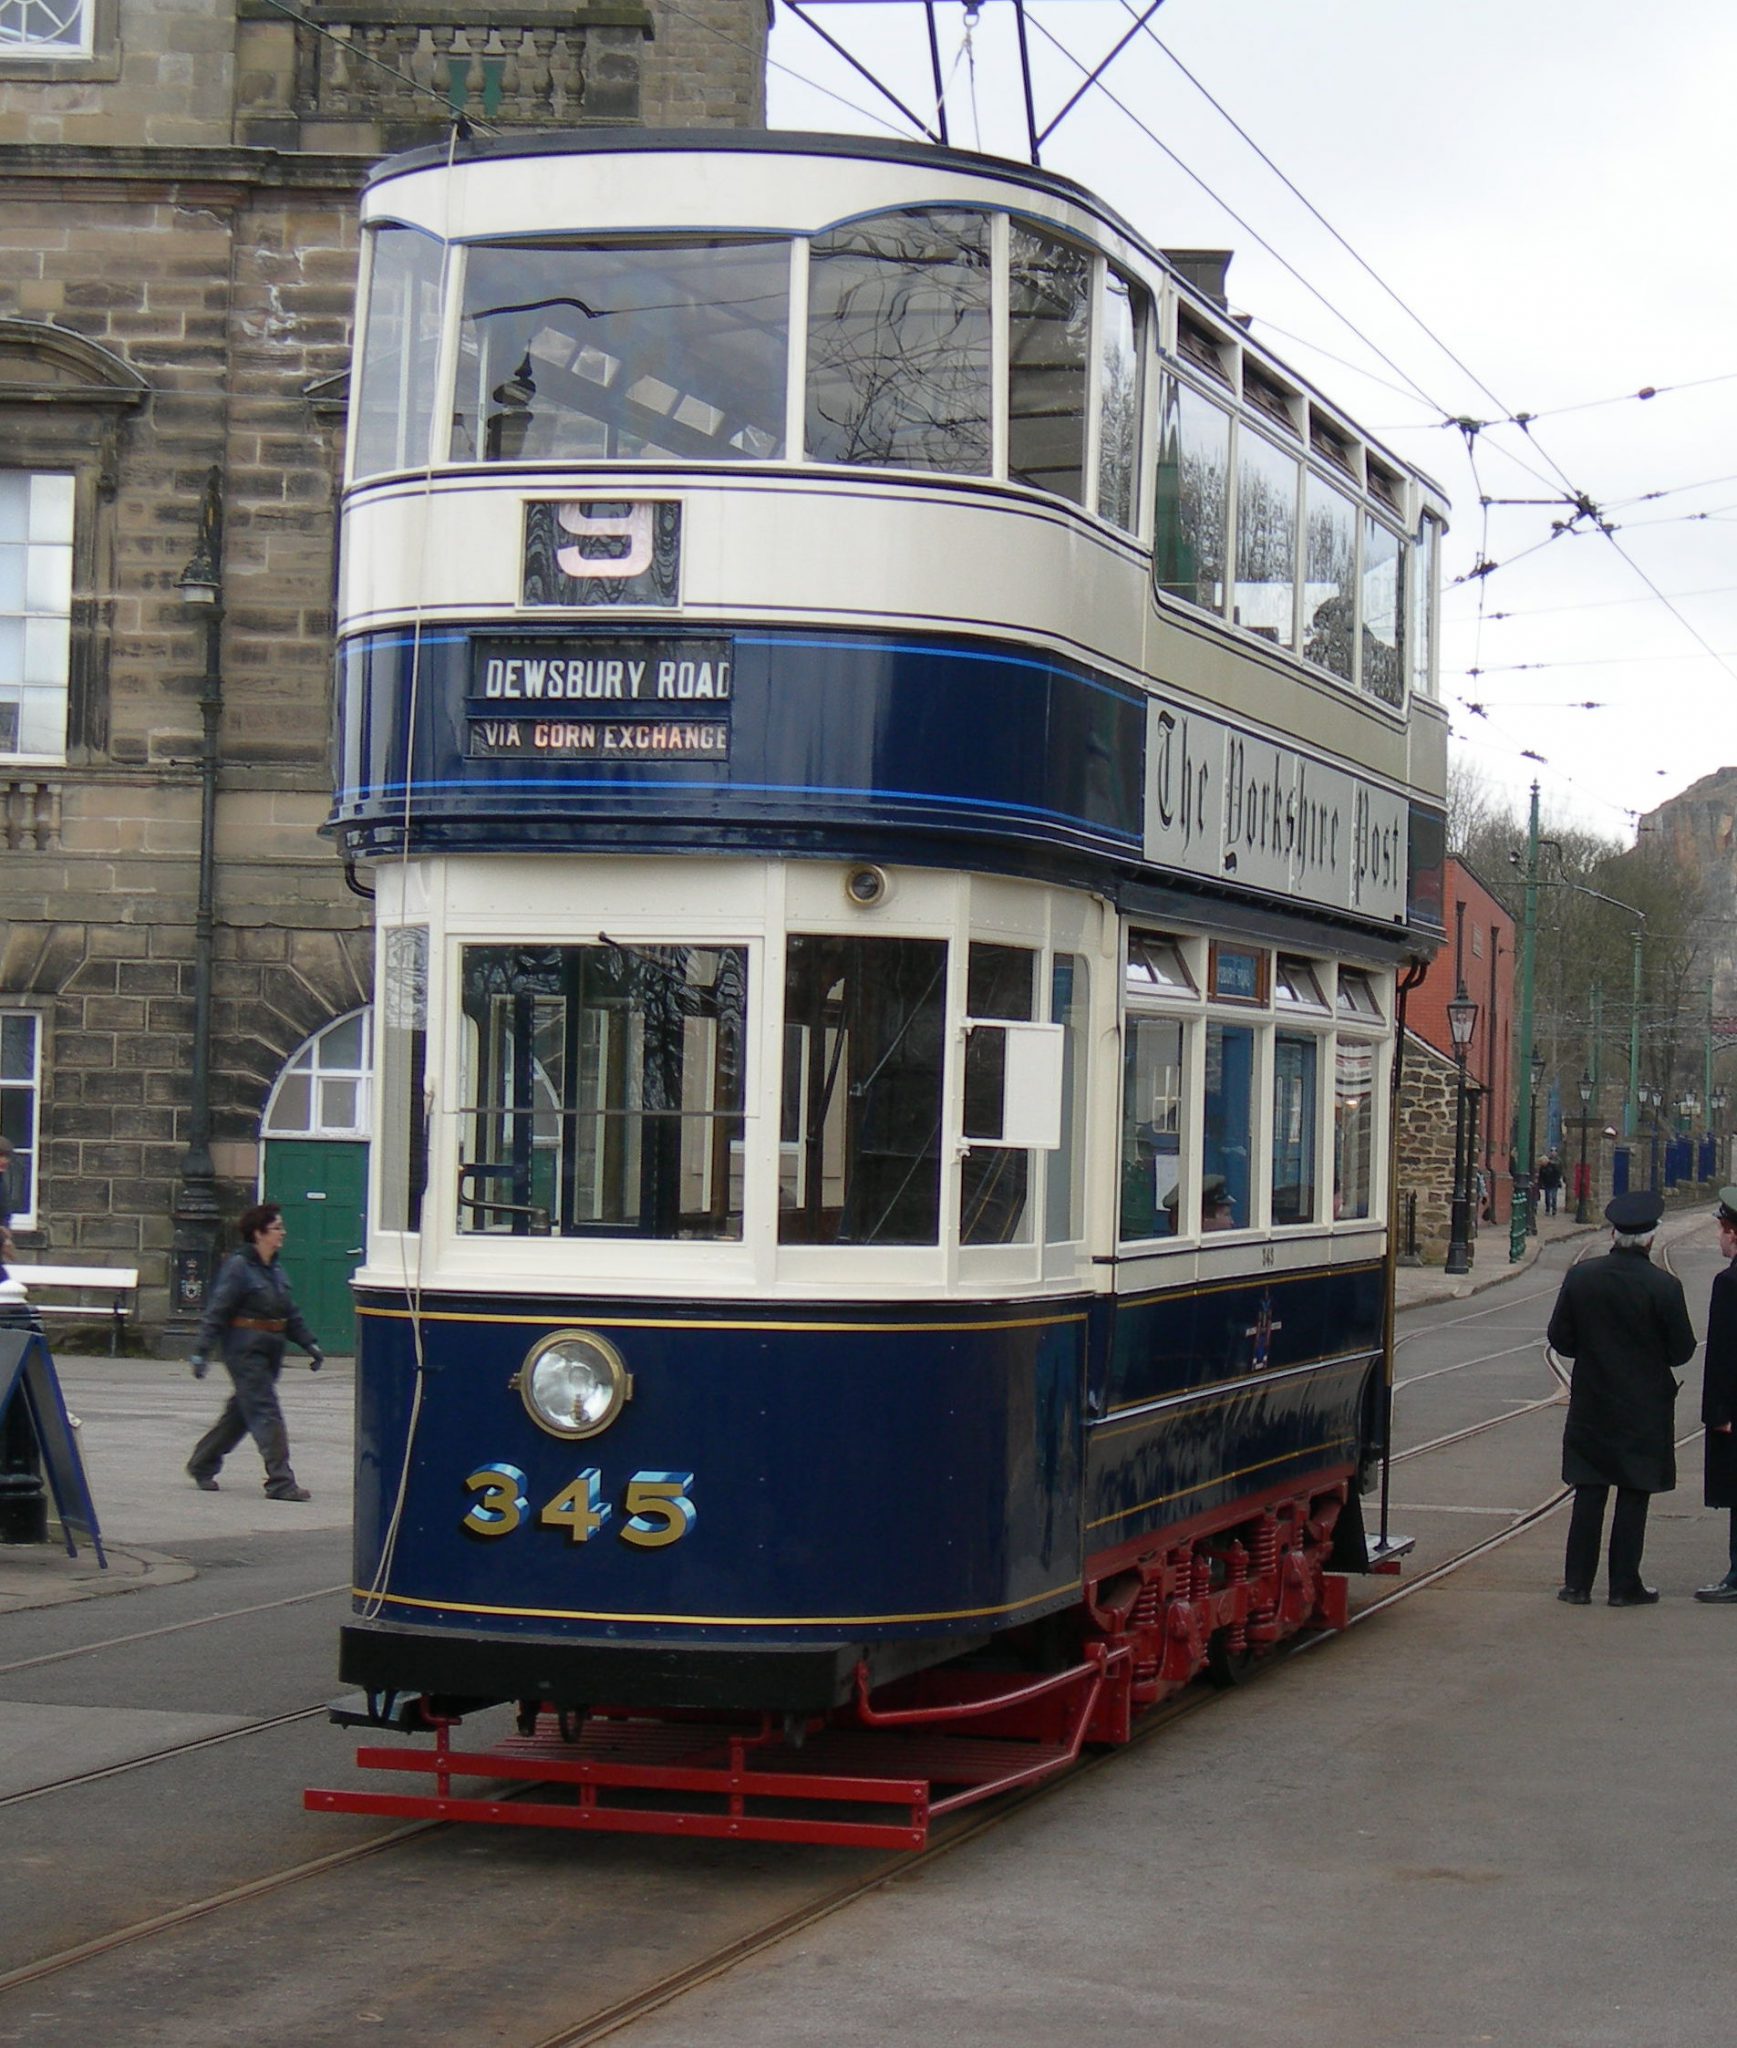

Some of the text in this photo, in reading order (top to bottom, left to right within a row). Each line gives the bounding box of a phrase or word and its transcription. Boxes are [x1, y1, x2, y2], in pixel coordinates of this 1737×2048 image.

[556, 502, 653, 577] 9
[485, 659, 730, 699] DEWSBURY ROAD
[485, 723, 727, 749] VIA CORN EXCHANGE
[1157, 709, 1399, 906] The Yorkshire Post
[462, 1462, 698, 1548] 345
